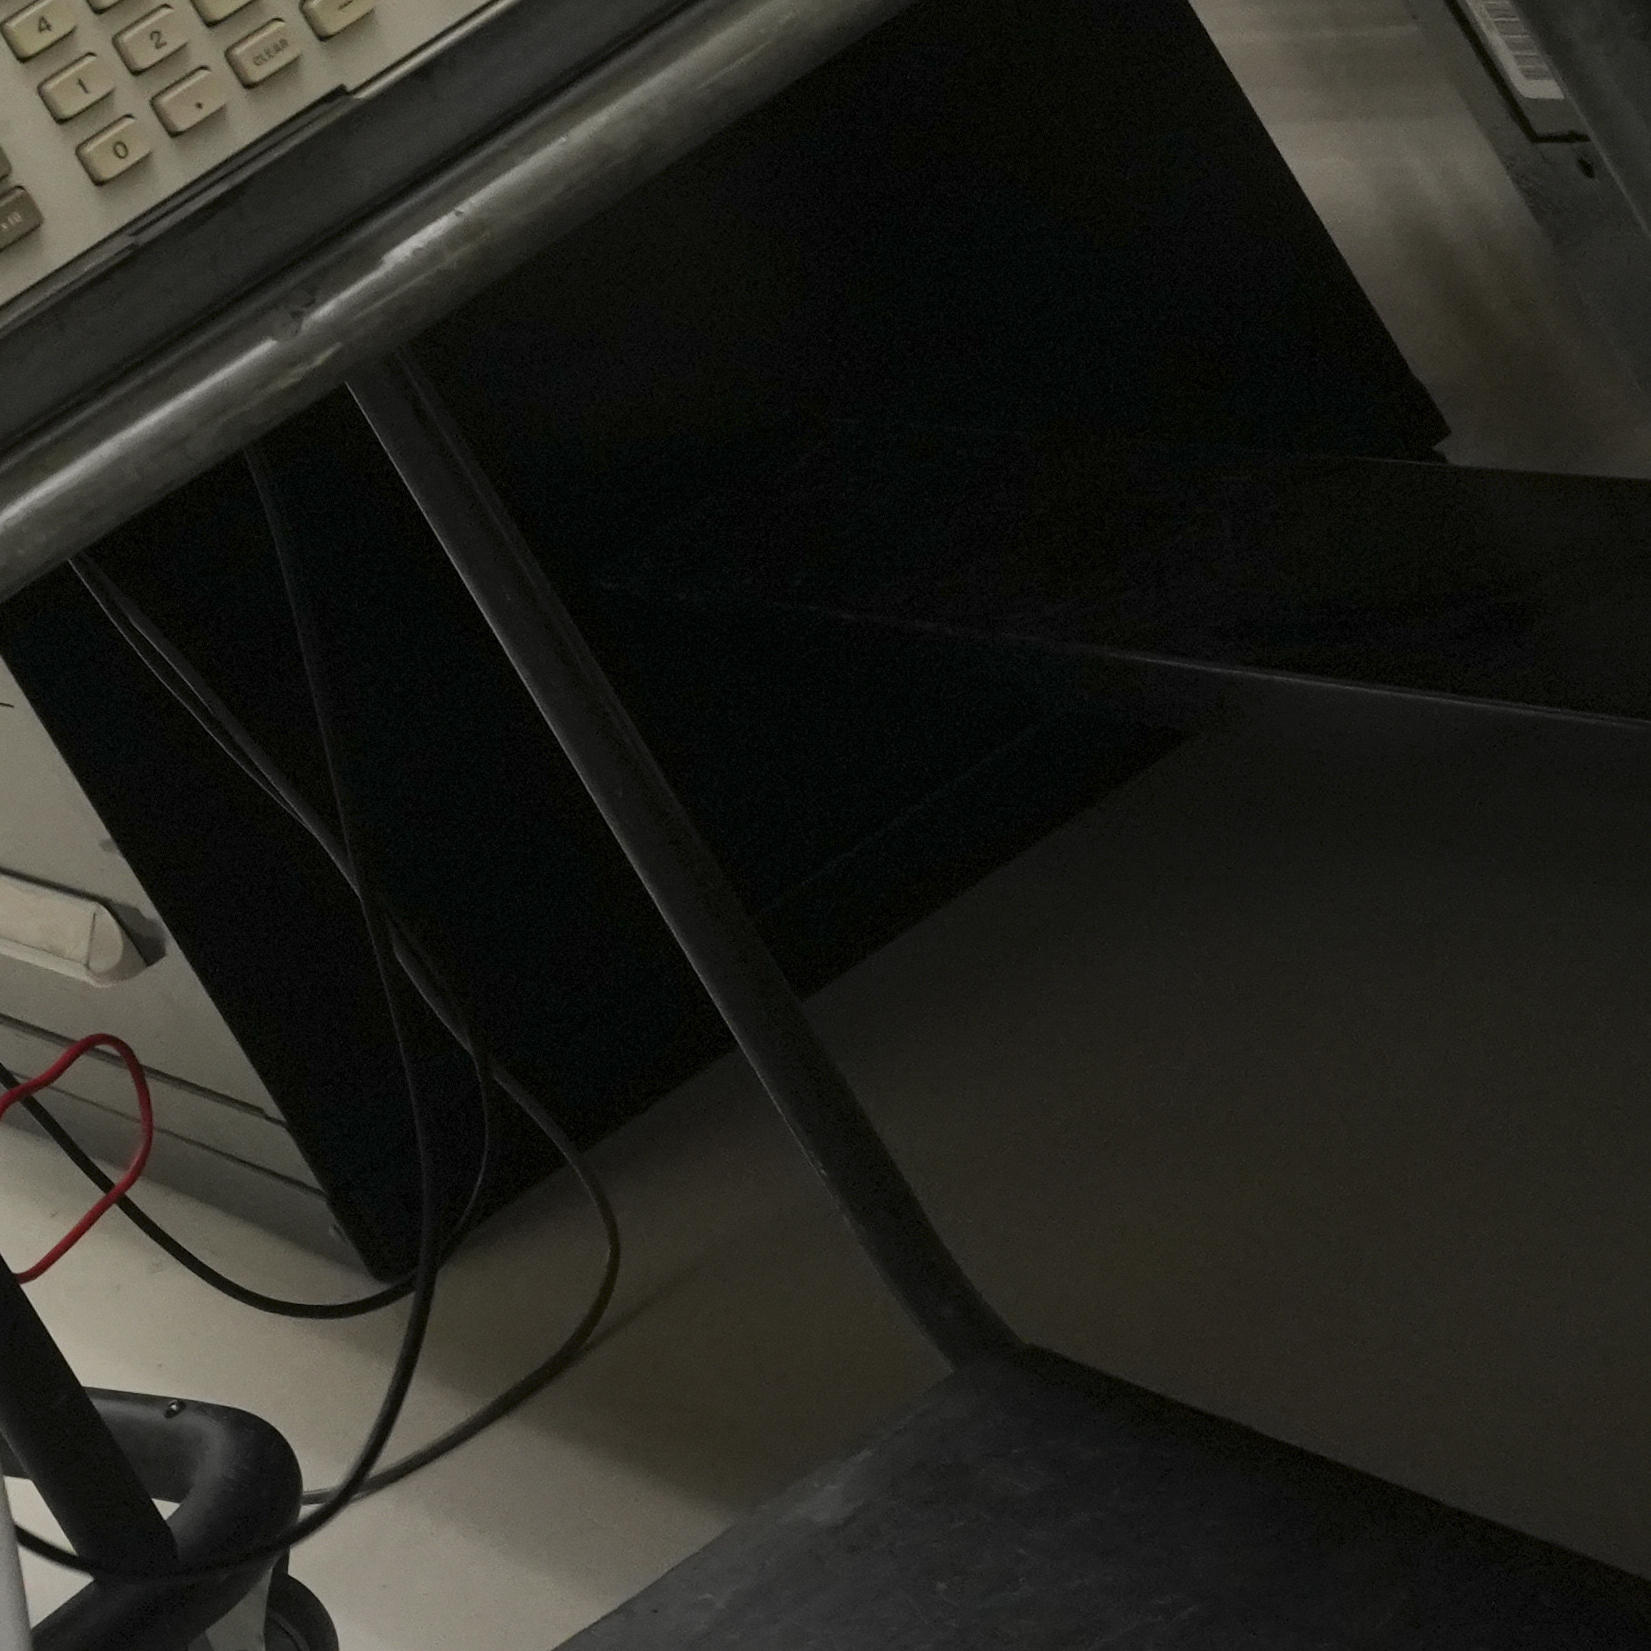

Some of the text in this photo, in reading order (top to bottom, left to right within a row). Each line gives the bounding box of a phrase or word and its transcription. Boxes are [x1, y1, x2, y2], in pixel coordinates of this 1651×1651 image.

[32, 13, 55, 37] 4
[147, 28, 168, 51] 2
[250, 36, 291, 69] CLEAR
[74, 77, 90, 97] 1
[109, 138, 131, 161] 0
